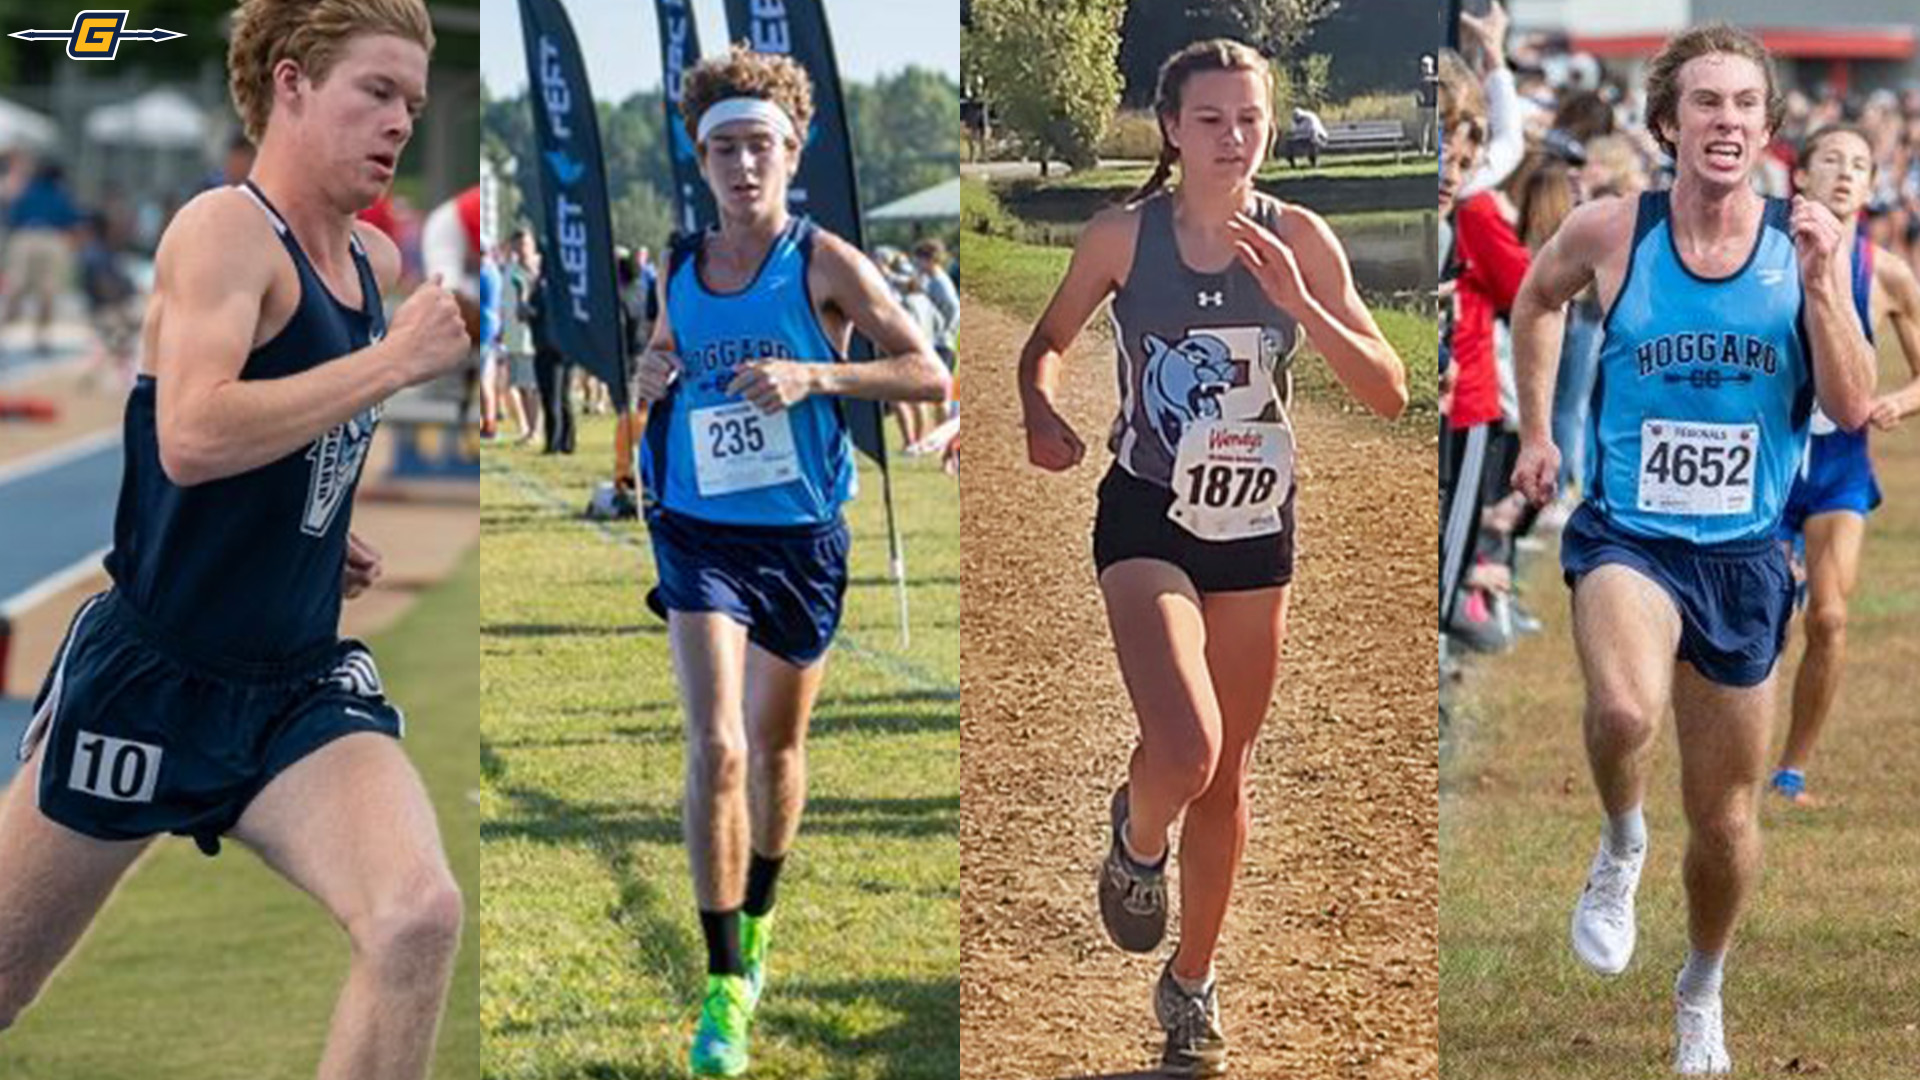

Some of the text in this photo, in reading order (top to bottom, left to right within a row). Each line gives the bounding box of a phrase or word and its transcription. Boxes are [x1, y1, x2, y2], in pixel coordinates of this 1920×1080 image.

[558, 193, 590, 322] FLEET
[1637, 333, 1777, 377] HOGGARD
[709, 416, 764, 458] 235
[1187, 464, 1277, 507] 1878
[1646, 441, 1750, 487] 4652
[82, 738, 147, 798] 10
